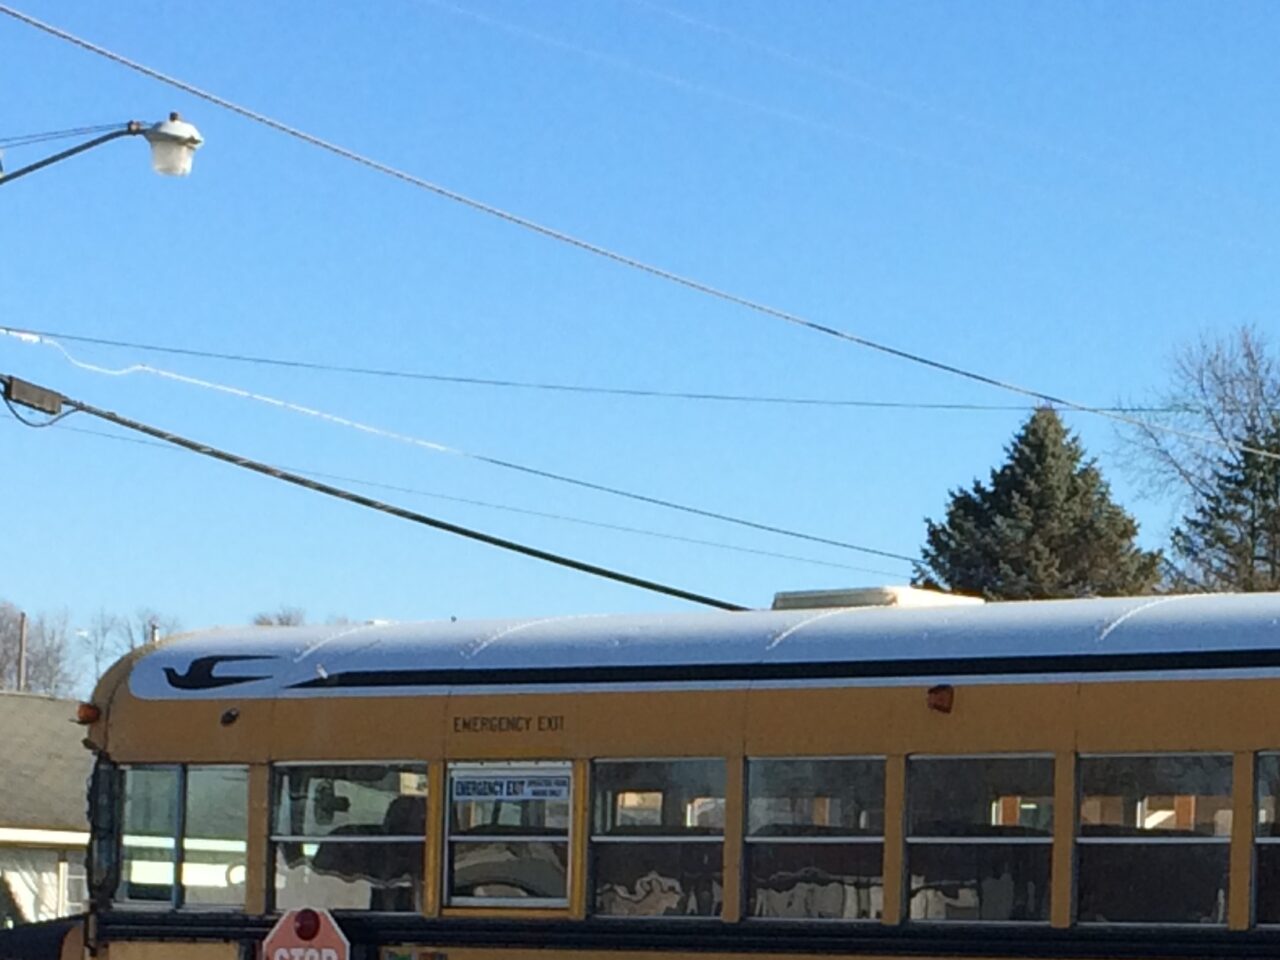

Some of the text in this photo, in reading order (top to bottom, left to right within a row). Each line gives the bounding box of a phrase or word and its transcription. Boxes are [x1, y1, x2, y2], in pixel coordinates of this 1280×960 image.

[453, 716, 564, 732] EMERGENCY EXIT
[455, 780, 504, 796] EMERGENCY
[506, 780, 525, 796] EXIT
